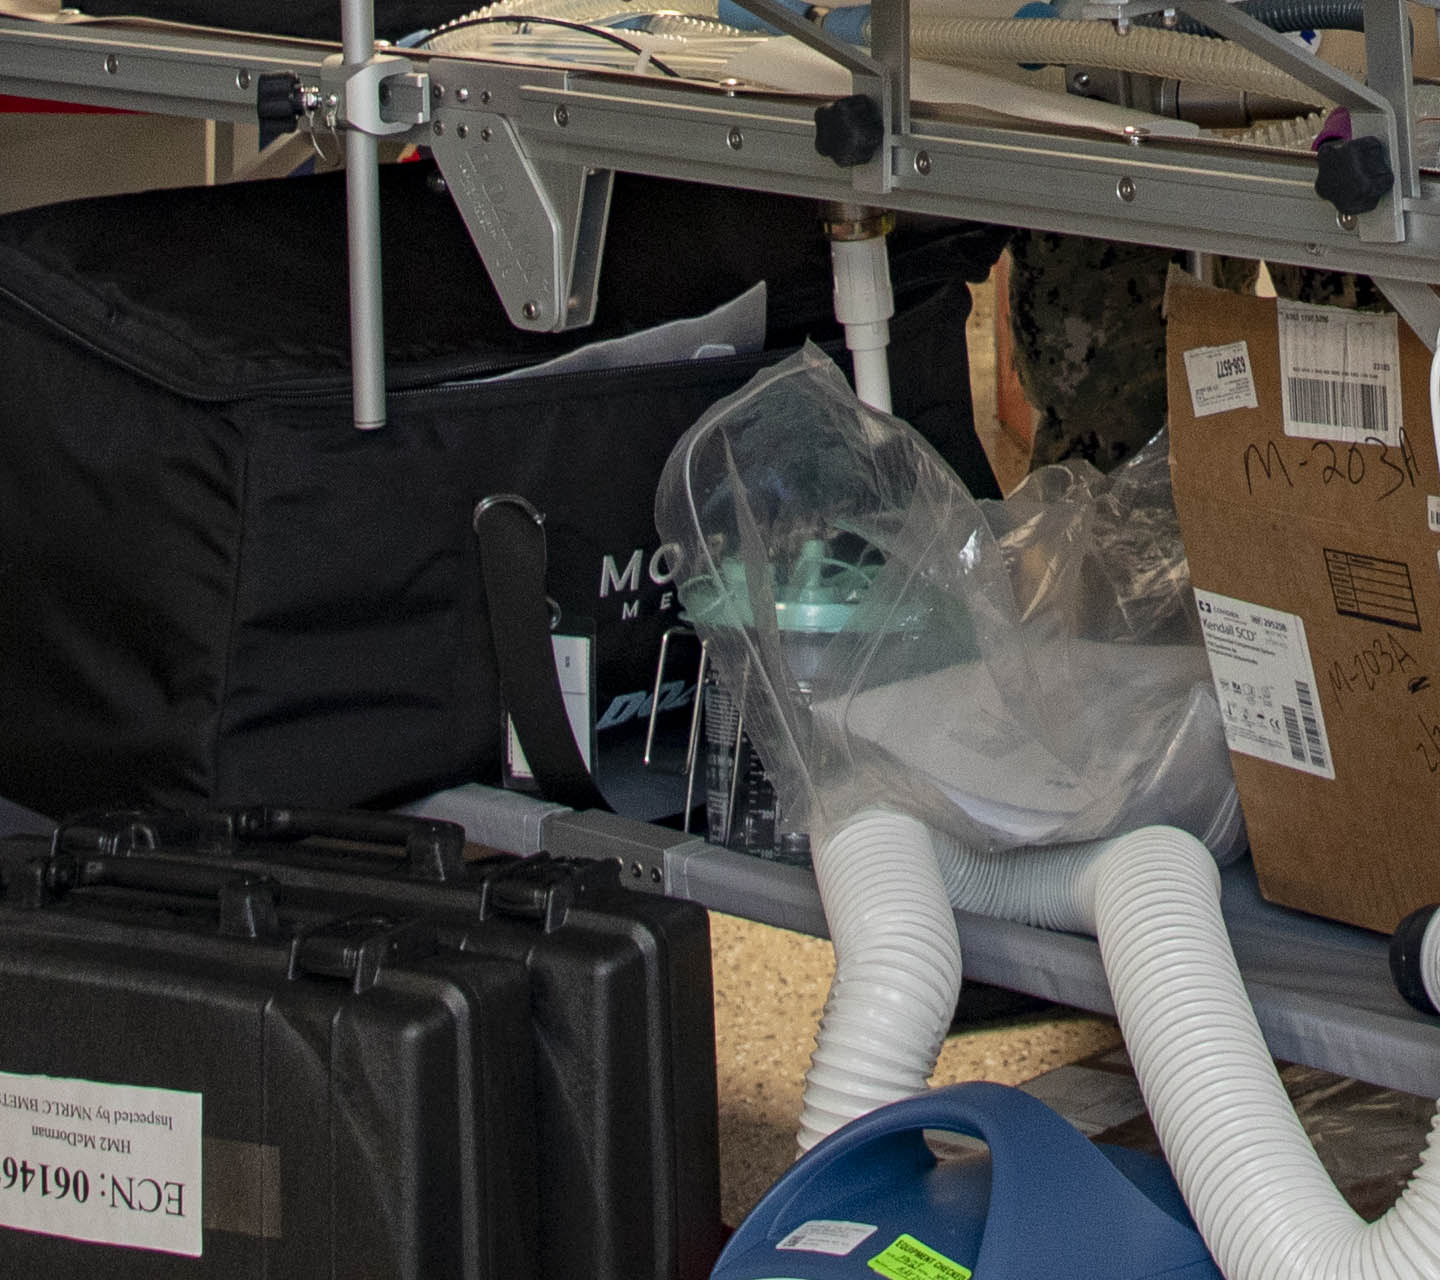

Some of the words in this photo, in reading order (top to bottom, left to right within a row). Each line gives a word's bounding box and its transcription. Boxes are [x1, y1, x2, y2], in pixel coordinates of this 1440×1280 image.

[42, 1099, 93, 1121] NMRLC
[96, 1106, 111, 1123] by
[114, 1110, 173, 1130] Inspected
[31, 1125, 96, 1150] McDorman
[99, 1136, 131, 1154] HM2
[100, 1172, 186, 1218] ECN:
